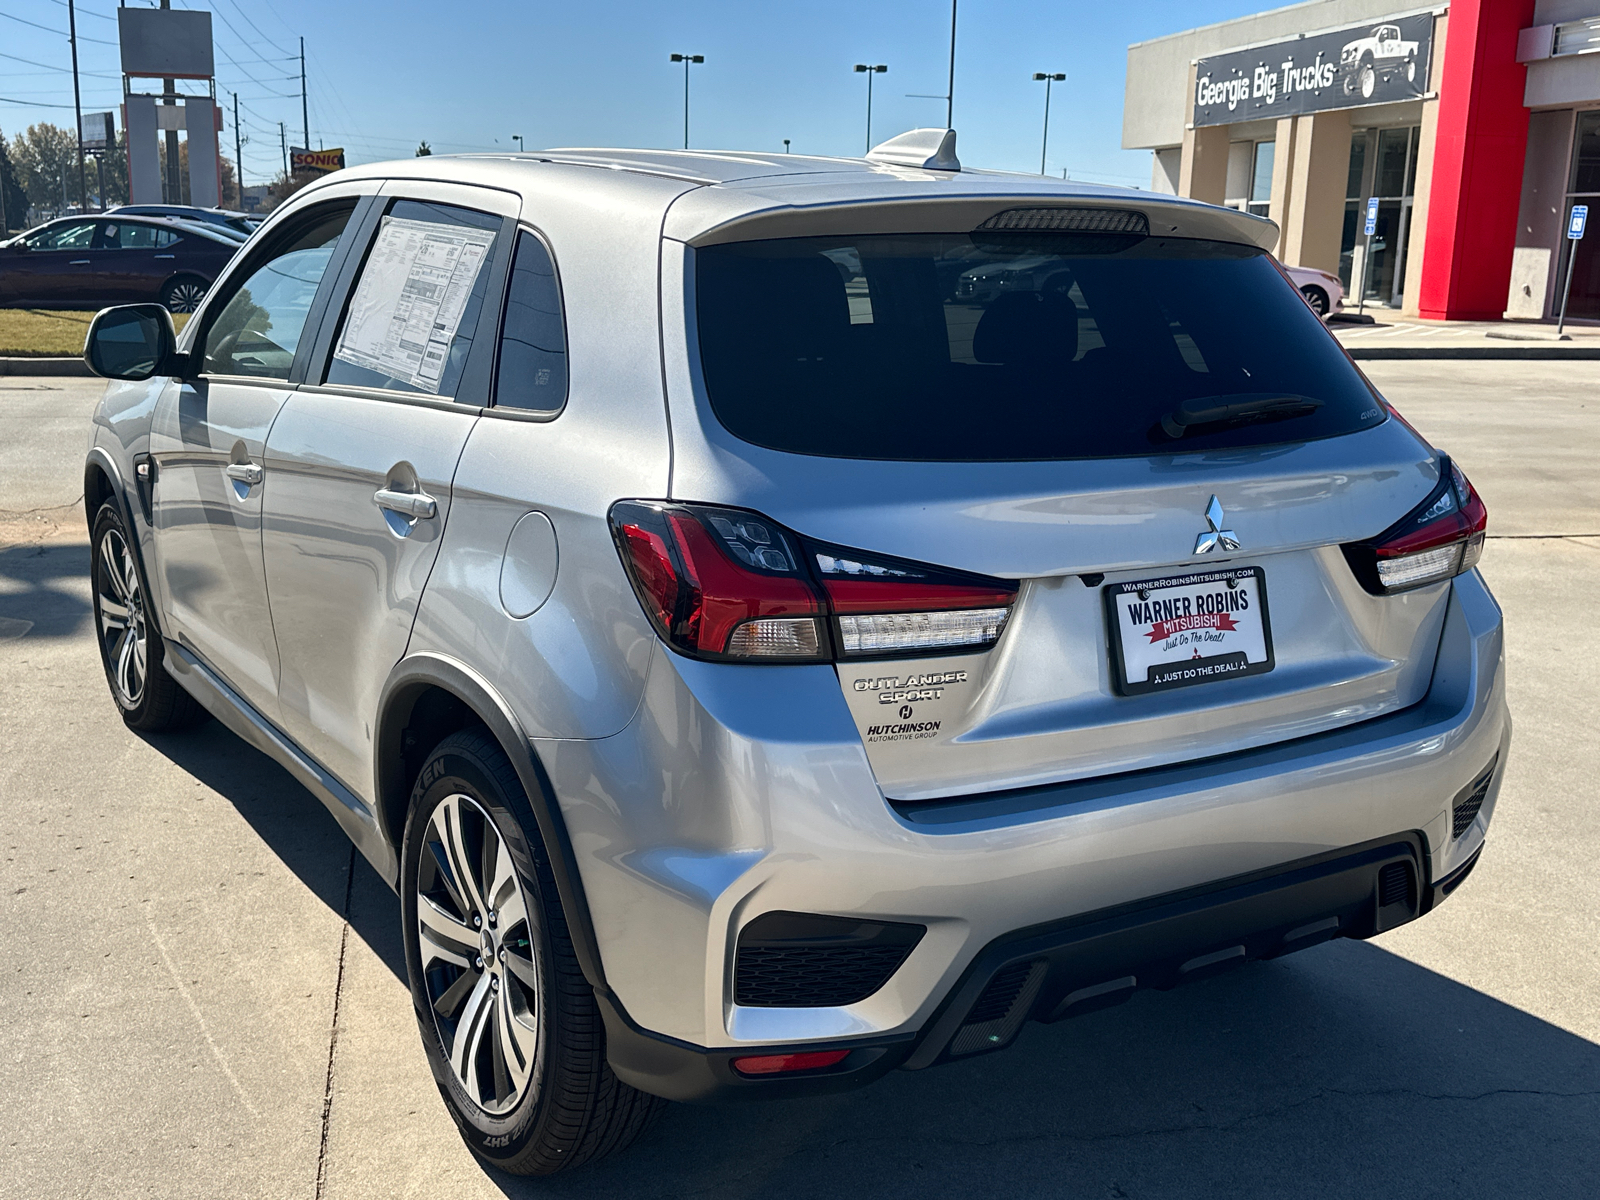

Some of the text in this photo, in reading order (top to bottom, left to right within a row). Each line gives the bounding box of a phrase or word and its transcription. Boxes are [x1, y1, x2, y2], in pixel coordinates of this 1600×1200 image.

[1252, 64, 1277, 104] Big
[1281, 56, 1334, 94] Trucks
[296, 153, 339, 166] SONIC
[1360, 408, 1378, 420] 4WD
[1128, 589, 1249, 625] WARNER ROBINS
[1162, 614, 1220, 634] MITSUBISHI
[1162, 632, 1226, 652] Just Do The Deal!
[854, 670, 968, 691] OUTLANDER
[1162, 662, 1238, 682] JUST DO THE DEAL!
[879, 687, 944, 704] SPORT
[867, 721, 941, 735] HUTCHINSON
[868, 731, 938, 743] AUTOMOTIVE GROUP
